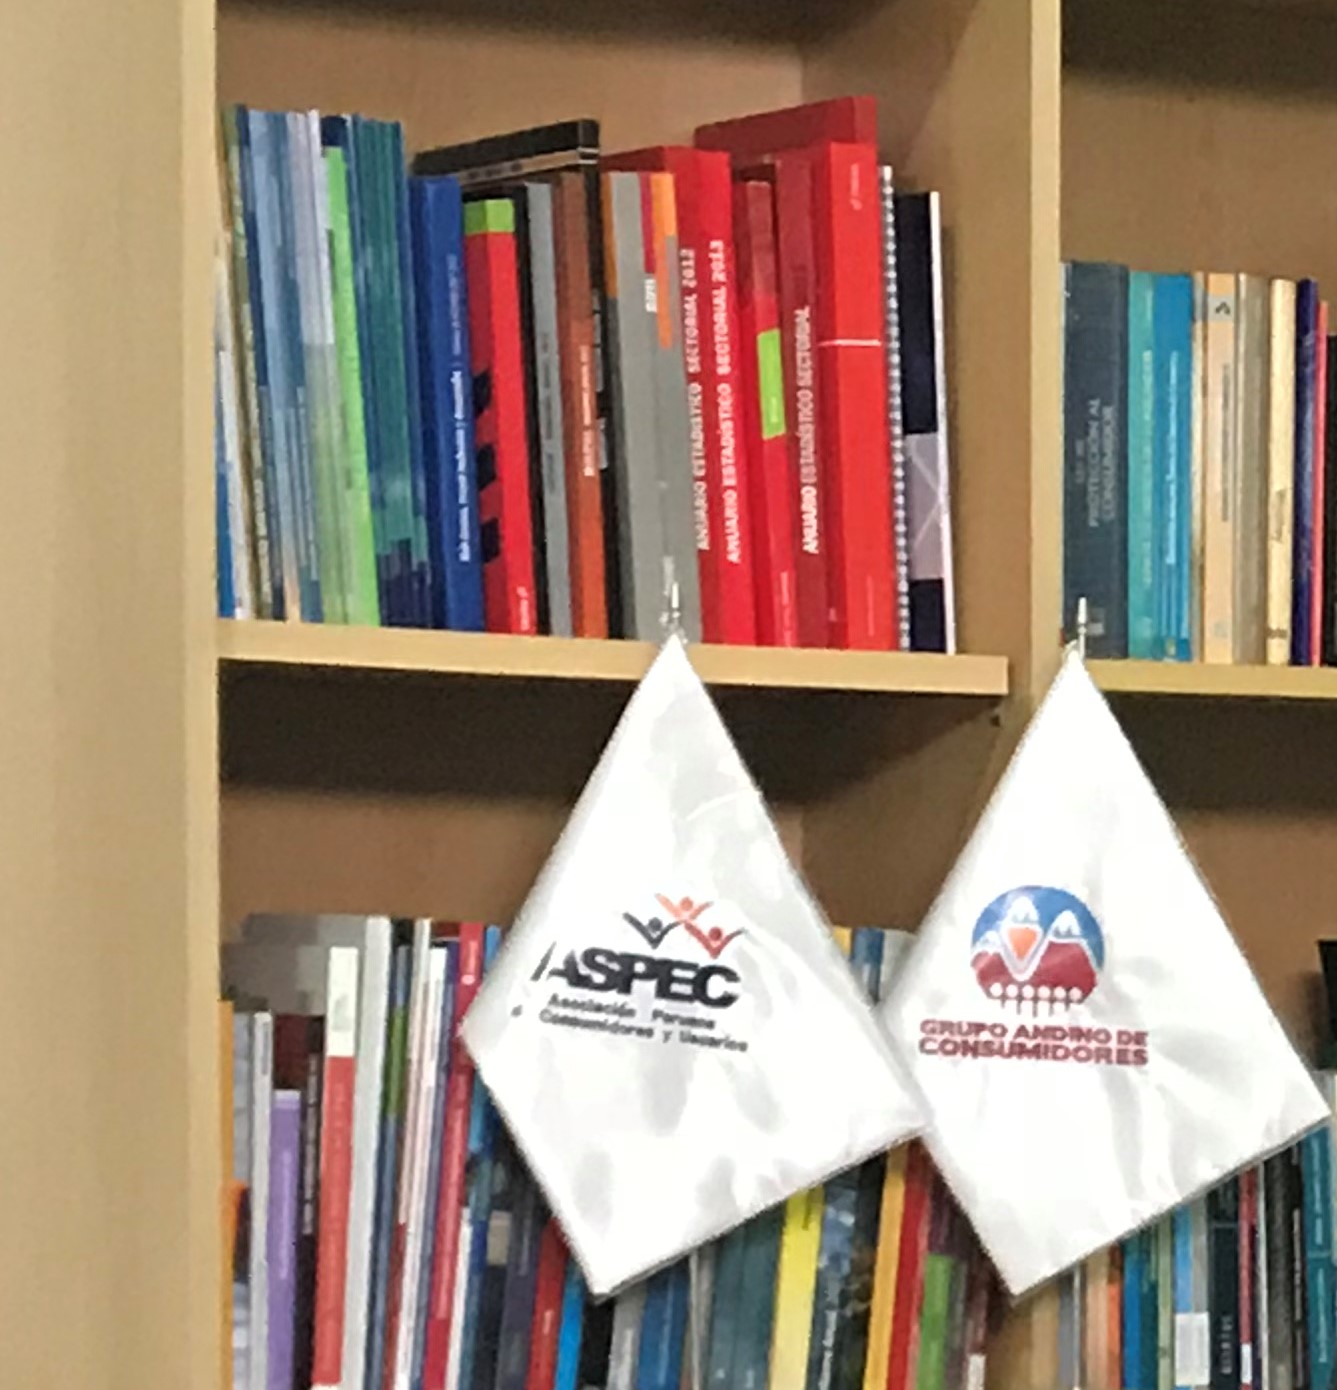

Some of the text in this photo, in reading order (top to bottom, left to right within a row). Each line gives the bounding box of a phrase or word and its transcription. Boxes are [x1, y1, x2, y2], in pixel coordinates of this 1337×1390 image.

[530, 941, 741, 1009] ASPEC
[919, 1018, 1149, 1048] GRUPO ANDINO DE
[918, 1036, 1149, 1066] CONSUMIDORES
